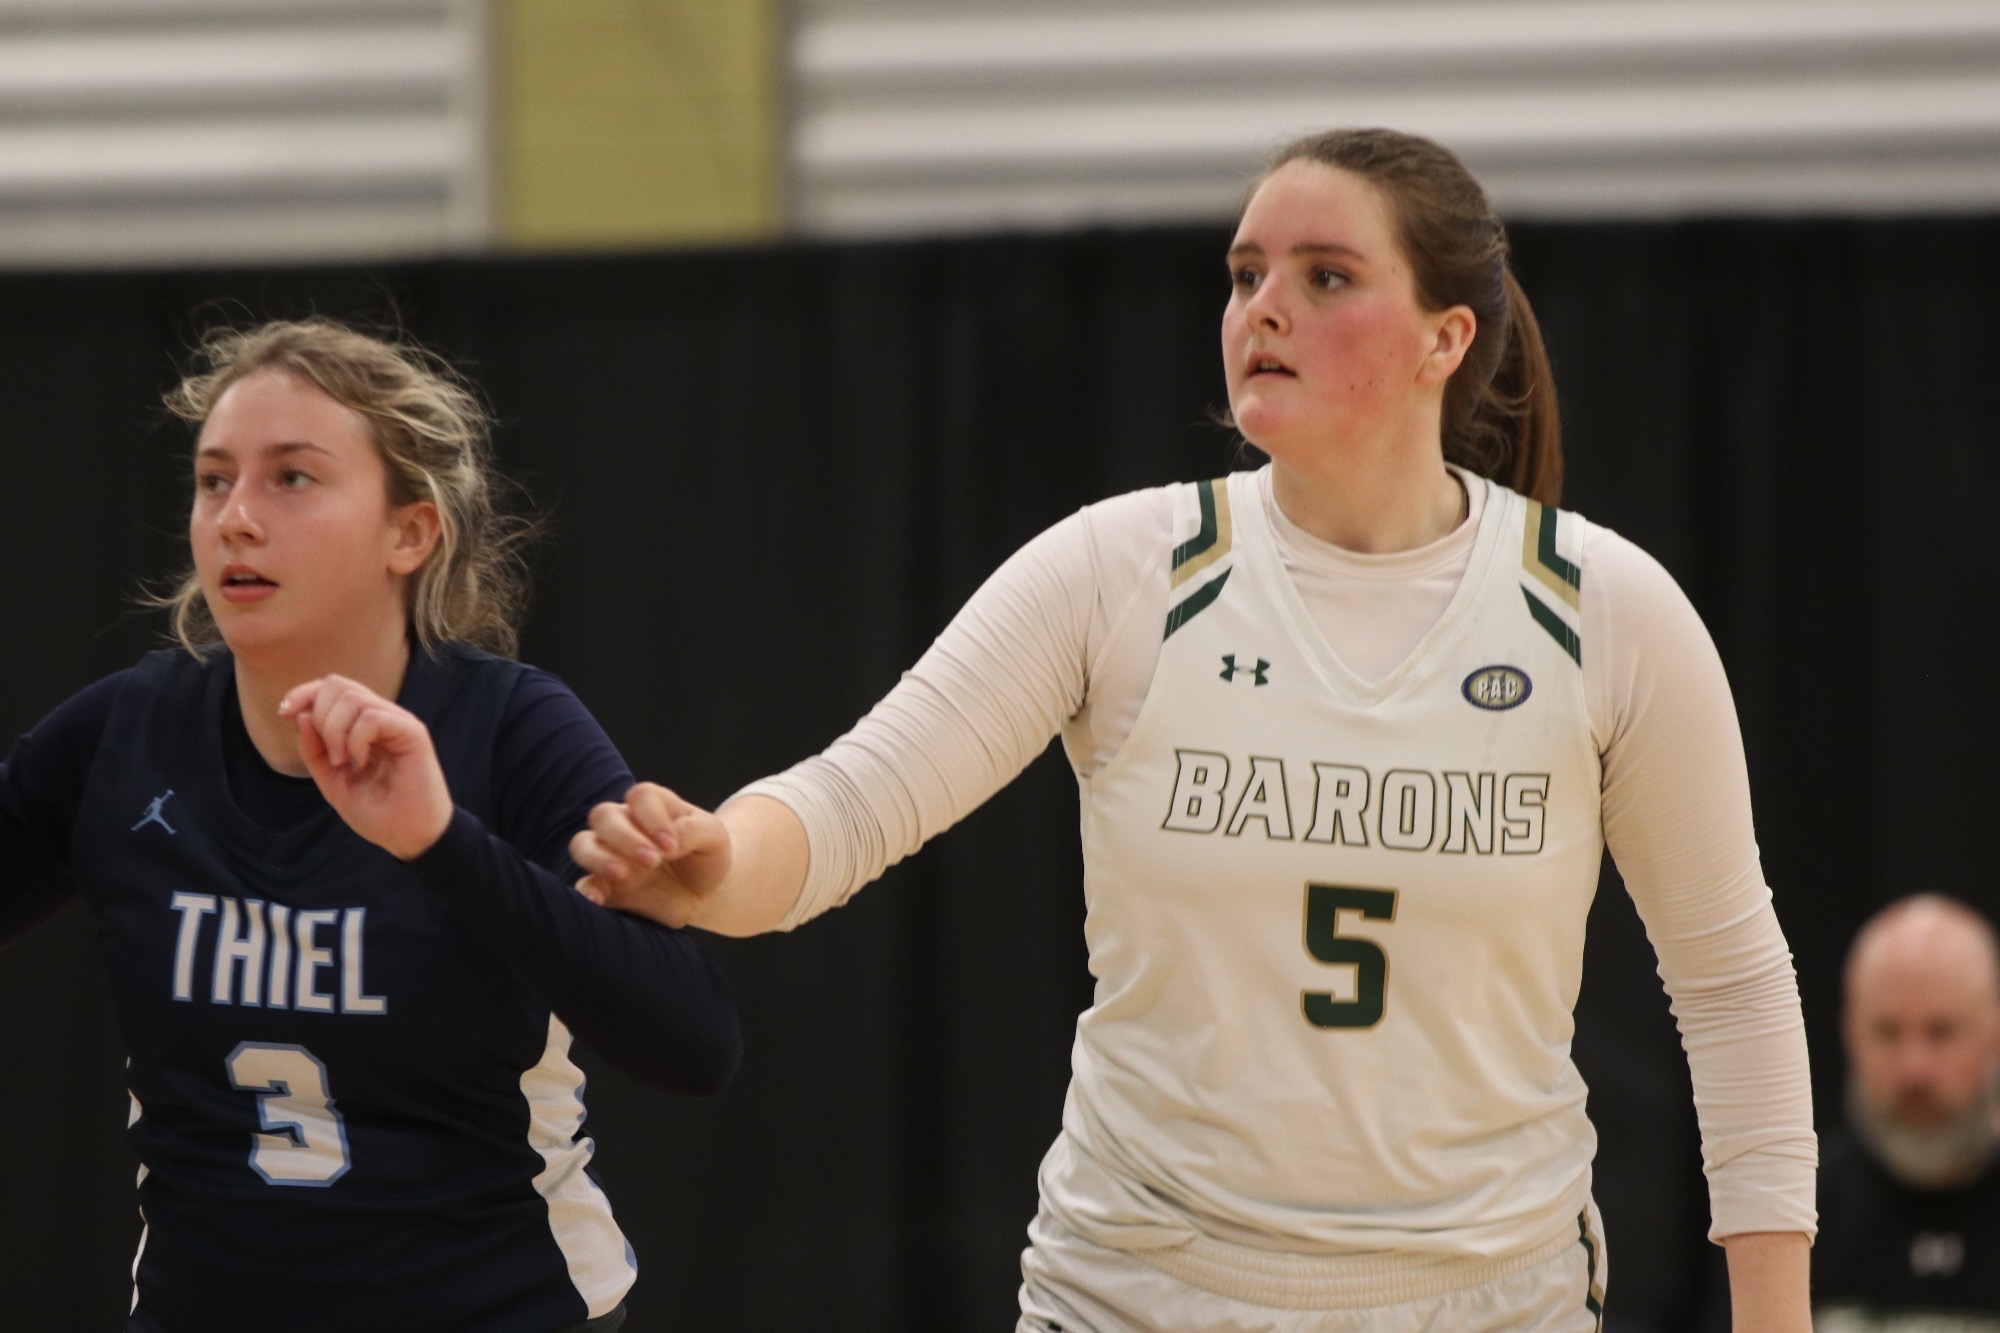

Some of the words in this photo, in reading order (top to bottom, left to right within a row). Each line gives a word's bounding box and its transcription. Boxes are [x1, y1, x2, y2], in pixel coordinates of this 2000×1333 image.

[1477, 678, 1518, 700] PAC
[1160, 748, 1551, 856] BARONS
[170, 890, 388, 1015] THIEL
[1300, 880, 1400, 1033] 5
[224, 1040, 352, 1188] 3
